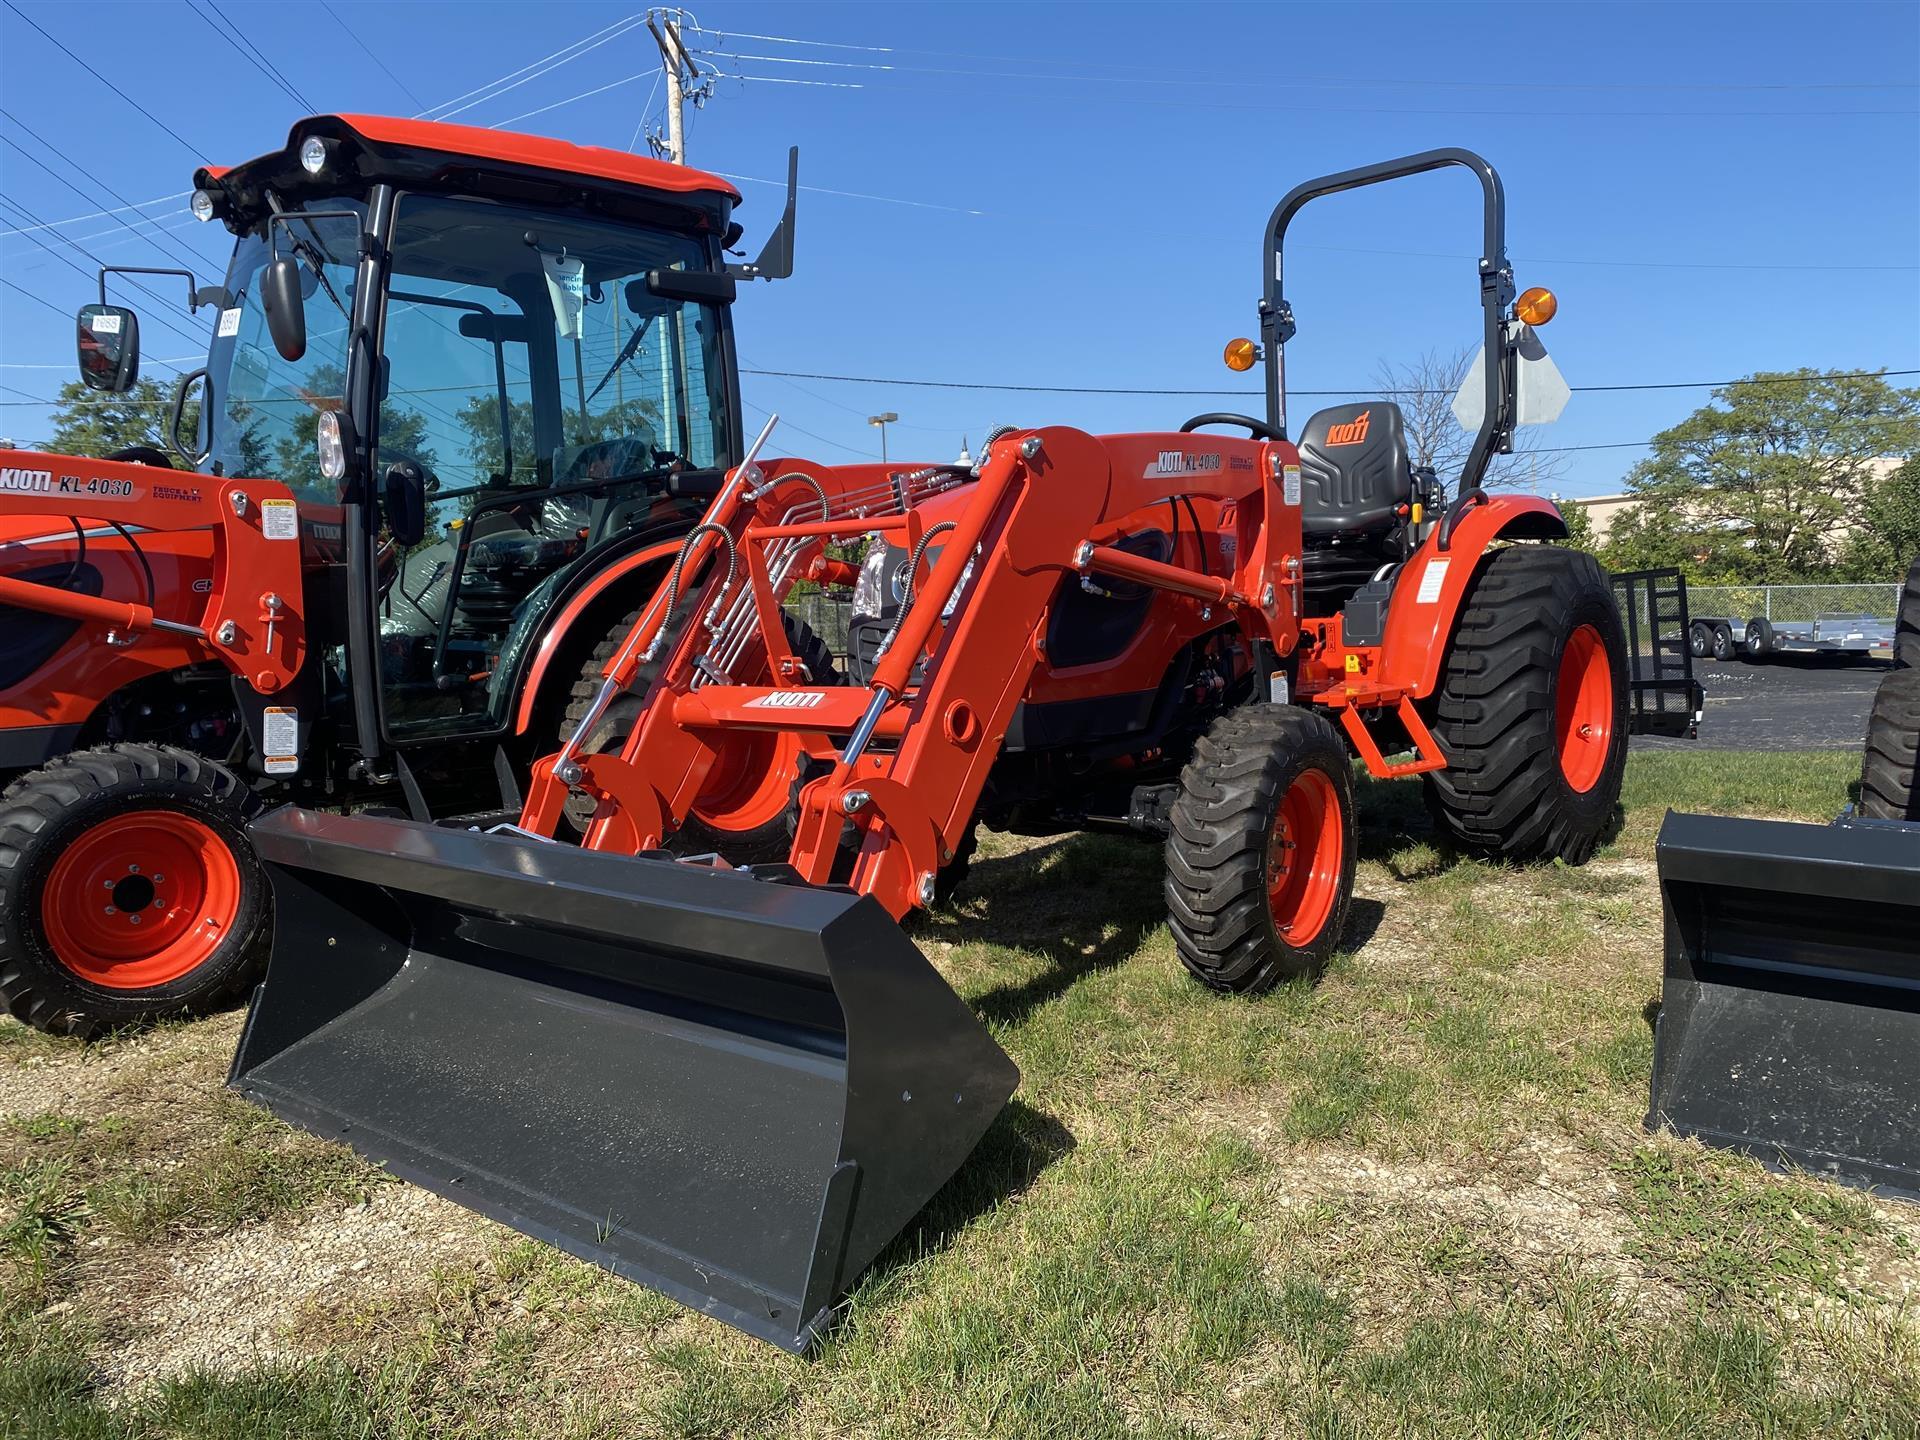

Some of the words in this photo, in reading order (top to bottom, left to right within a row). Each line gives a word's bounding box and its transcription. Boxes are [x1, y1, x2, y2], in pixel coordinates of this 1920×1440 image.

[1326, 417, 1370, 444] KIOTI
[1157, 450, 1183, 473] KIOTI
[1185, 454, 1197, 471] KL
[1198, 453, 1221, 471] 4030
[0, 467, 52, 492] KIOTI
[60, 476, 82, 493] KL
[87, 476, 133, 497] 4030
[153, 486, 181, 494] TRUCK
[152, 492, 202, 502] EQUIPMENT
[760, 691, 827, 708] KIOTI
